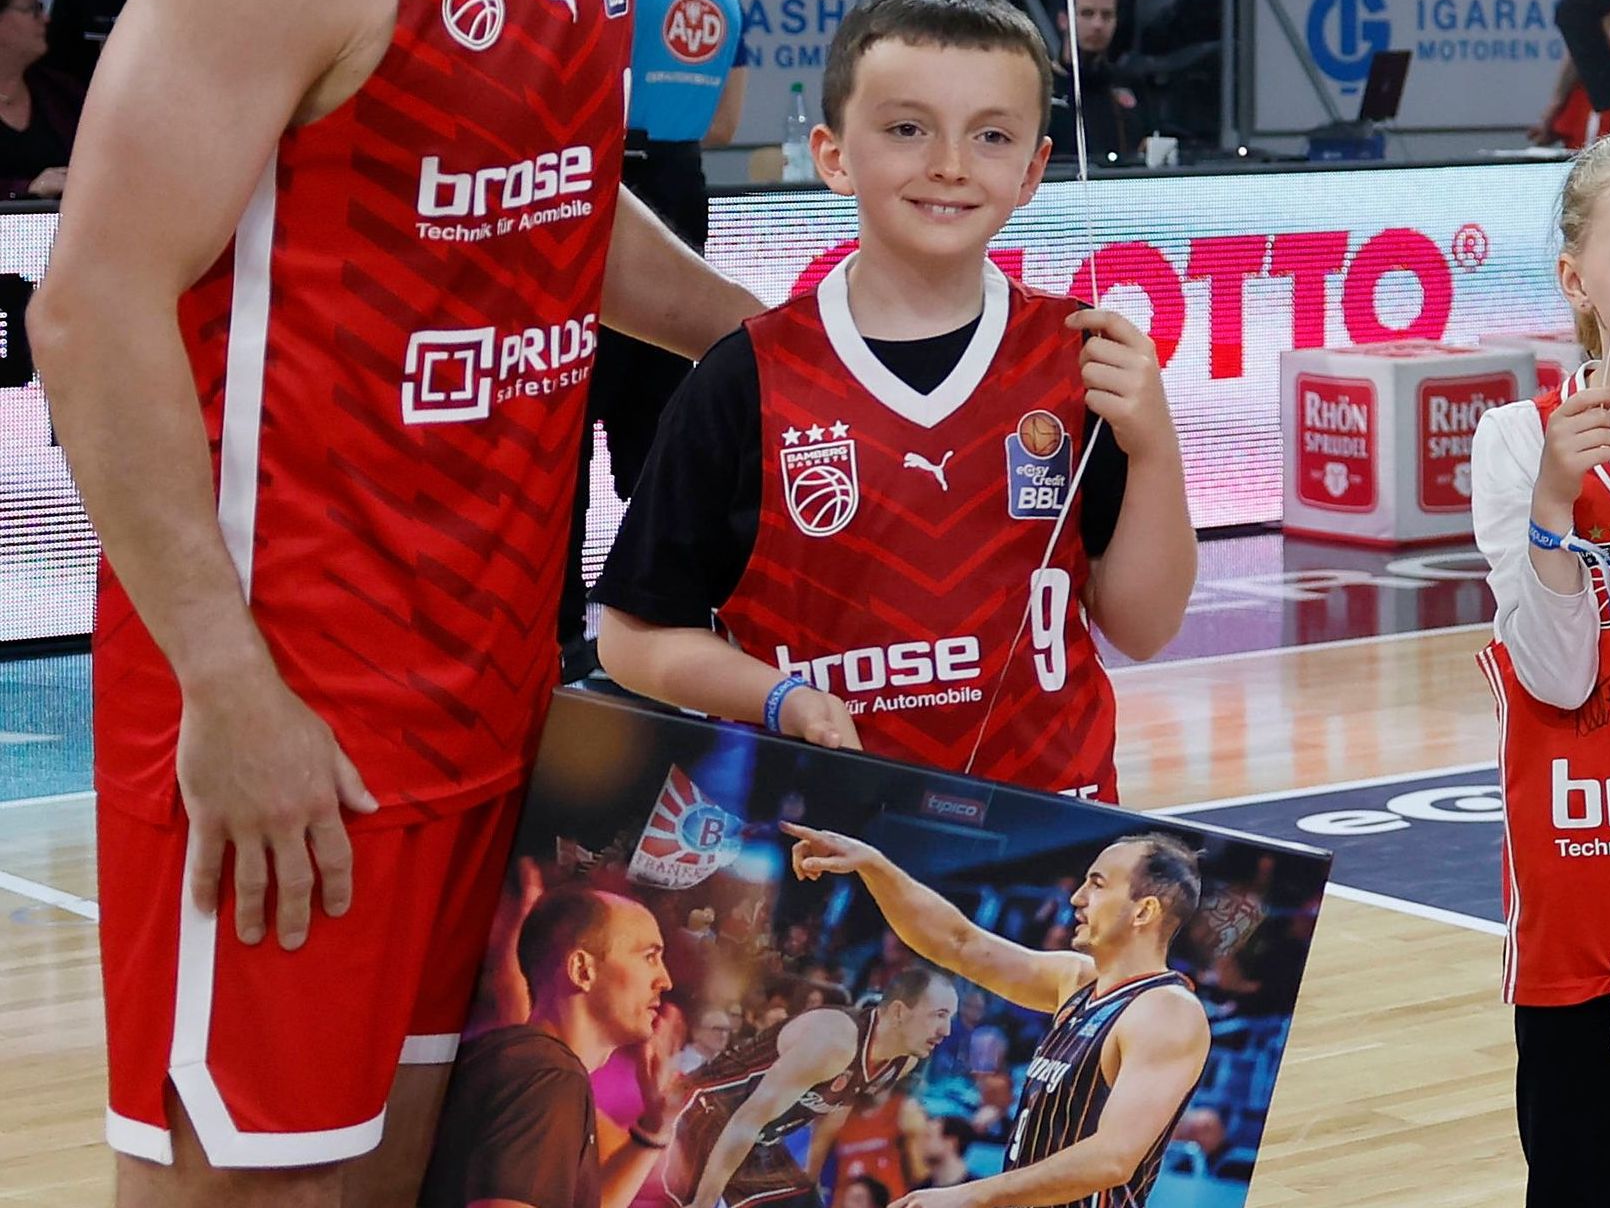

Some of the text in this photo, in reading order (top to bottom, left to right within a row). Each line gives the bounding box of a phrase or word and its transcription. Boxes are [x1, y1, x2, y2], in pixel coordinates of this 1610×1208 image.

[775, 46, 828, 68] GM
[1417, 38, 1565, 61] MOTOREN G
[417, 145, 593, 218] brose
[1304, 391, 1367, 433] RHÖN
[786, 446, 849, 464] BAMBERG
[1304, 432, 1368, 459] SPRUDEL
[1032, 474, 1066, 487] Credit
[1018, 487, 1066, 511] BBL
[1029, 567, 1070, 692] 9
[872, 685, 983, 714] Automobile
[926, 794, 978, 816] tipico
[699, 818, 724, 848] B
